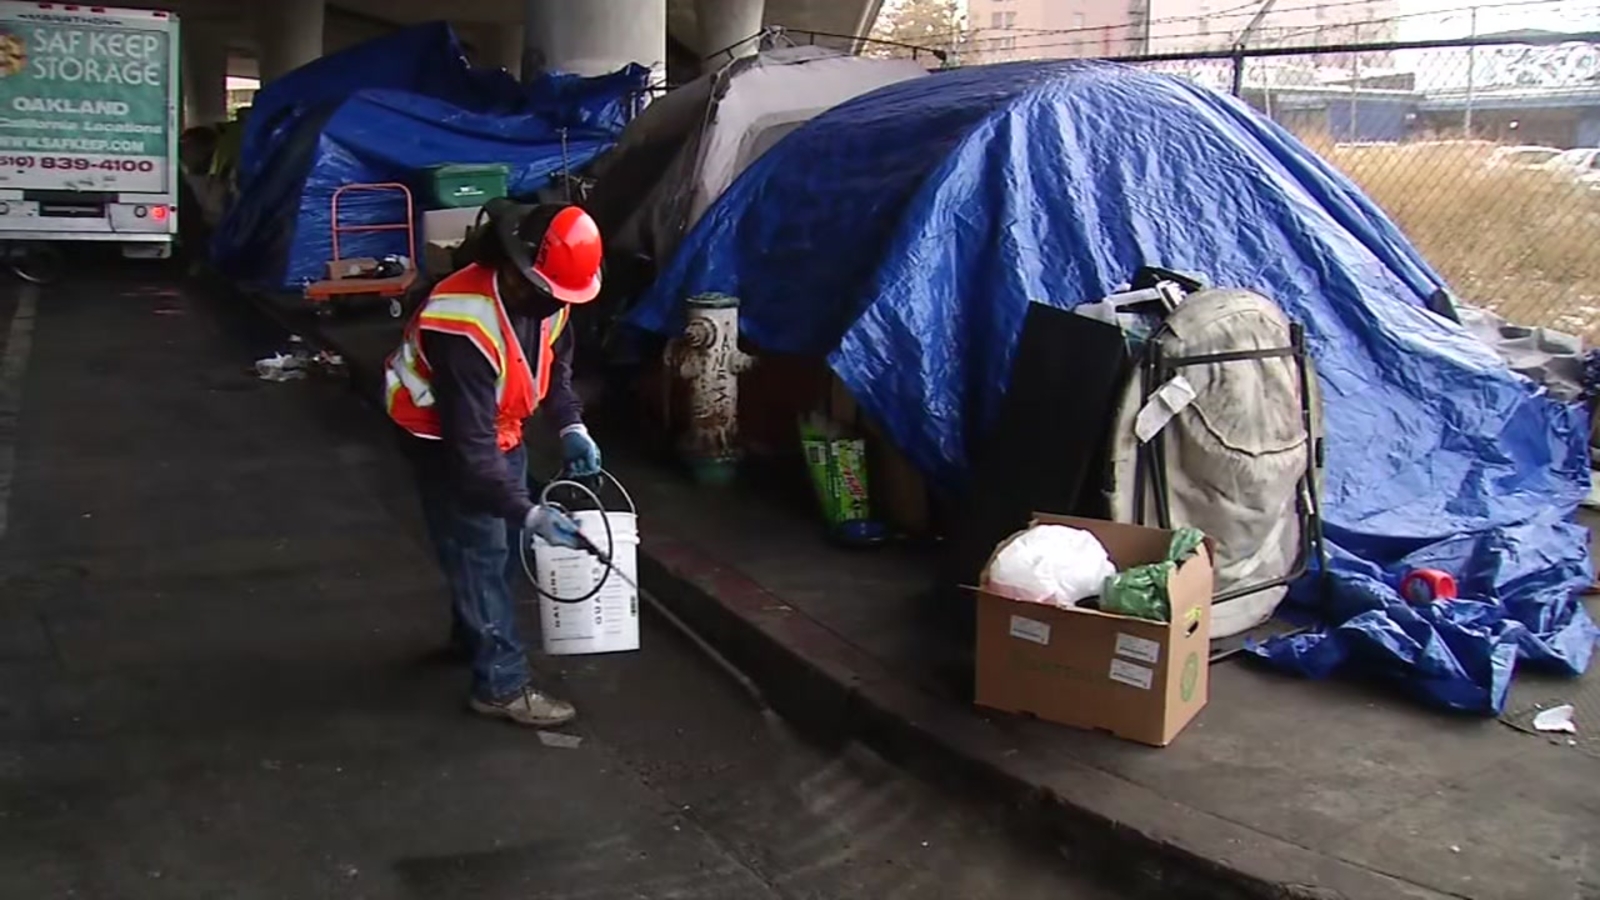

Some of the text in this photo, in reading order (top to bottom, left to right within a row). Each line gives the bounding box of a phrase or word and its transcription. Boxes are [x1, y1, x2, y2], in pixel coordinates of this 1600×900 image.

[33, 28, 159, 59] SAF KEEP
[32, 56, 161, 86] STORAGE
[12, 97, 130, 116] OAKLAND
[40, 157, 153, 172] 839-4100
[550, 570, 561, 628] GALONS
[591, 567, 603, 626] QUATS
